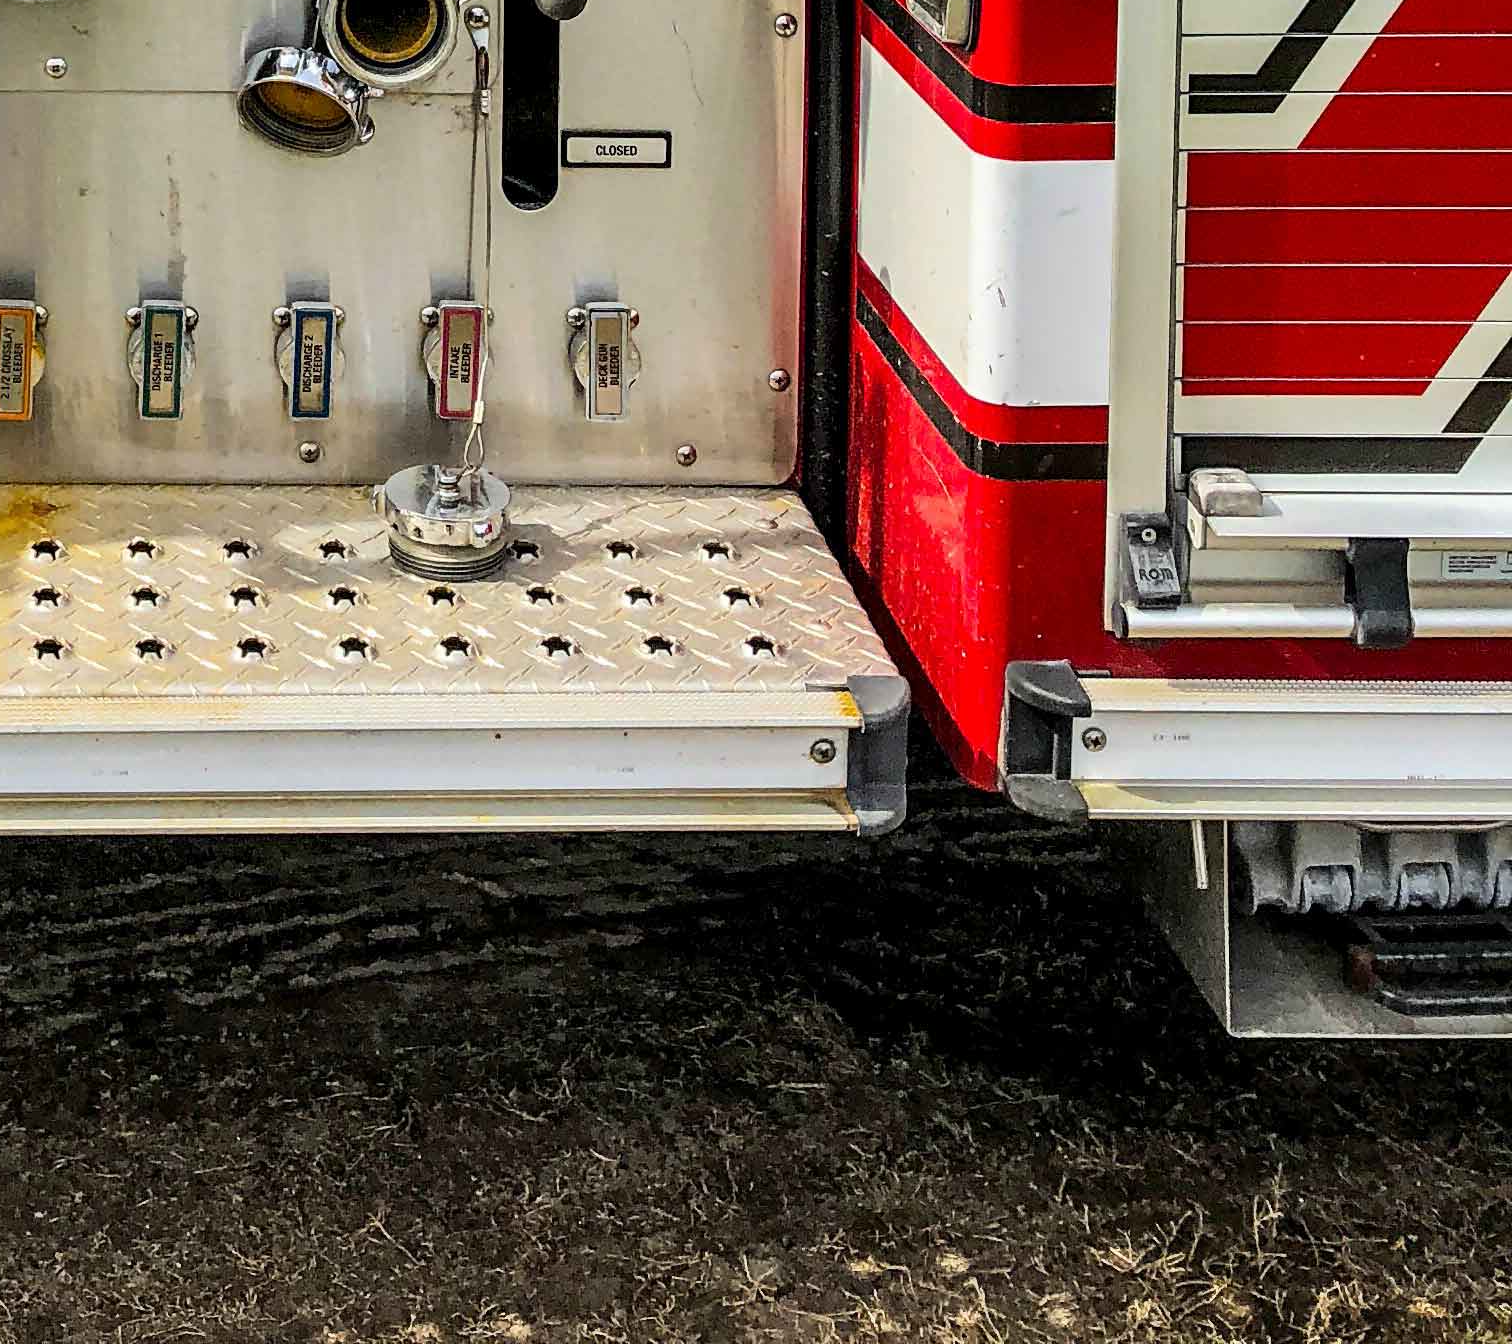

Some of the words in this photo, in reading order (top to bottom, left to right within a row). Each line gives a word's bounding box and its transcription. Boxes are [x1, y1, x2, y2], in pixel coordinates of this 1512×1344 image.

[595, 144, 637, 157] CLOSED
[2, 327, 14, 372] CROSSLAY
[12, 343, 23, 384] BLEEDER
[151, 341, 163, 391] DISCHARGE
[163, 341, 175, 382] BLEEDER
[302, 344, 314, 393] DISCHARGE
[312, 344, 323, 384] BLEEDER
[449, 346, 460, 379] INTAKE
[460, 343, 471, 384] BLEEDER
[599, 342, 610, 362] GUN
[609, 345, 621, 386] BLEEDER
[598, 363, 609, 388] DECK
